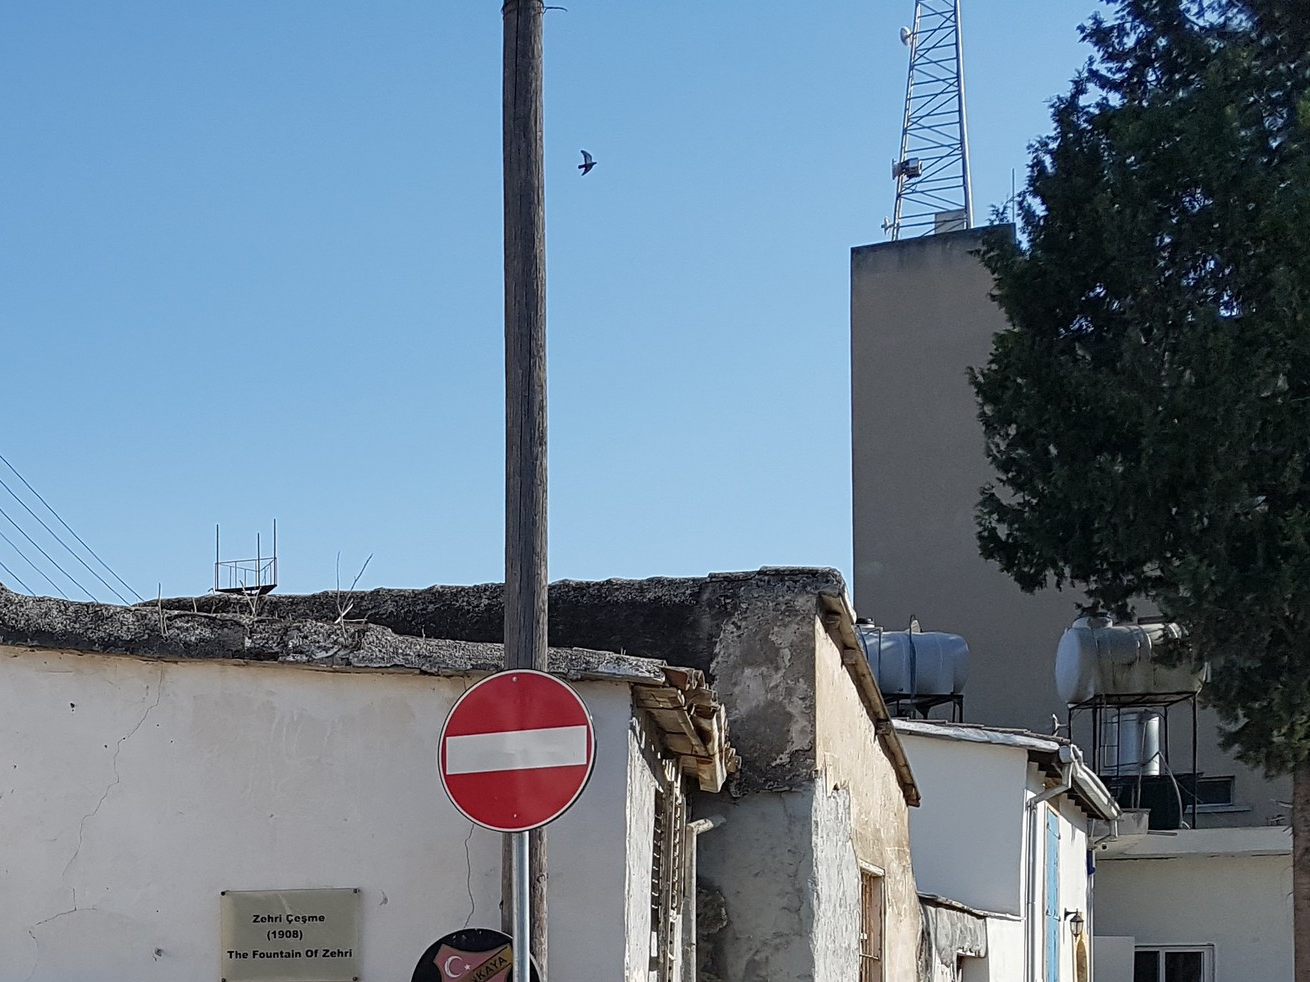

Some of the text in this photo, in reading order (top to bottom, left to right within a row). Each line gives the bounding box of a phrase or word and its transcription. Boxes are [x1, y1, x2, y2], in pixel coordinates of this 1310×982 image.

[252, 913, 326, 925] Zehri Çeşme
[266, 929, 303, 941] (1908)
[227, 949, 353, 959] The Fountain Of Zehri
